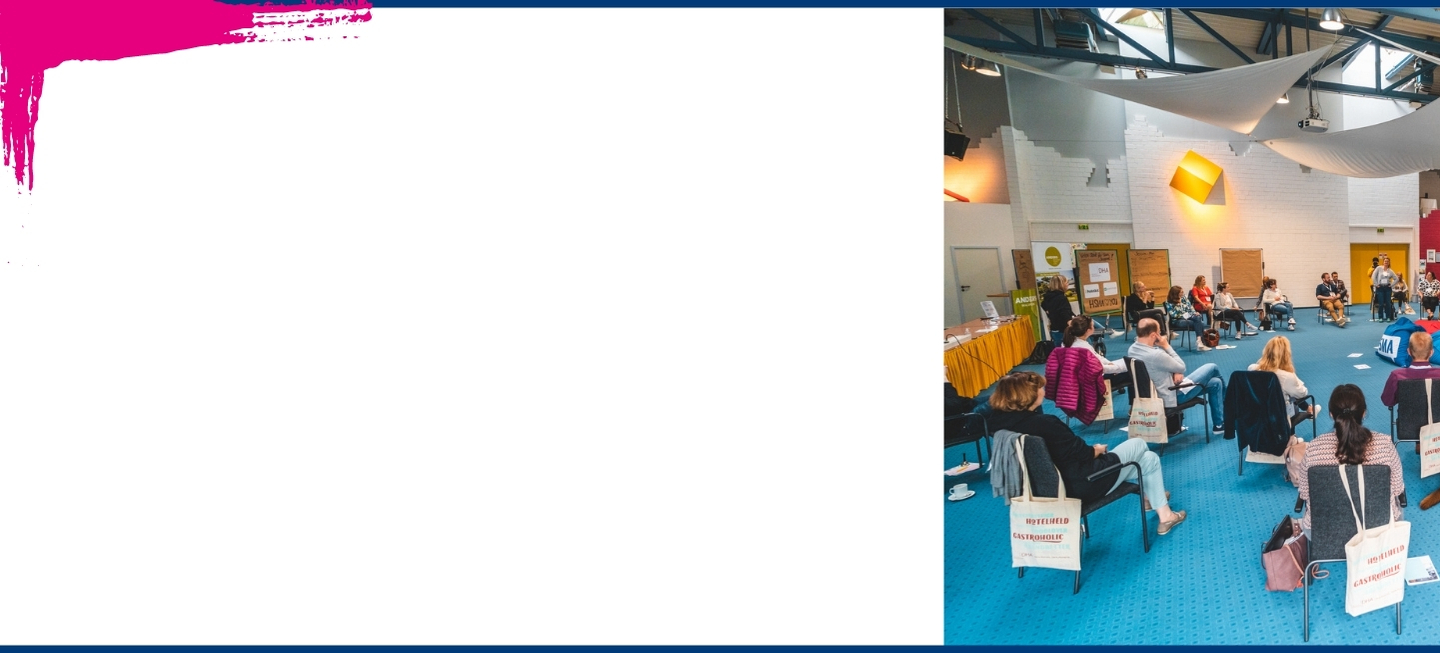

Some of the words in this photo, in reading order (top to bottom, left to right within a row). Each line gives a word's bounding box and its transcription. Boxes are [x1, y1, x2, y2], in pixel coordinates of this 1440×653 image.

[1026, 517, 1069, 525] HOTELHELD
[1013, 533, 1064, 543] GASTROHOLIC
[1367, 544, 1405, 565] HOTELHELD
[1353, 563, 1401, 587] GASTROHOLIC
